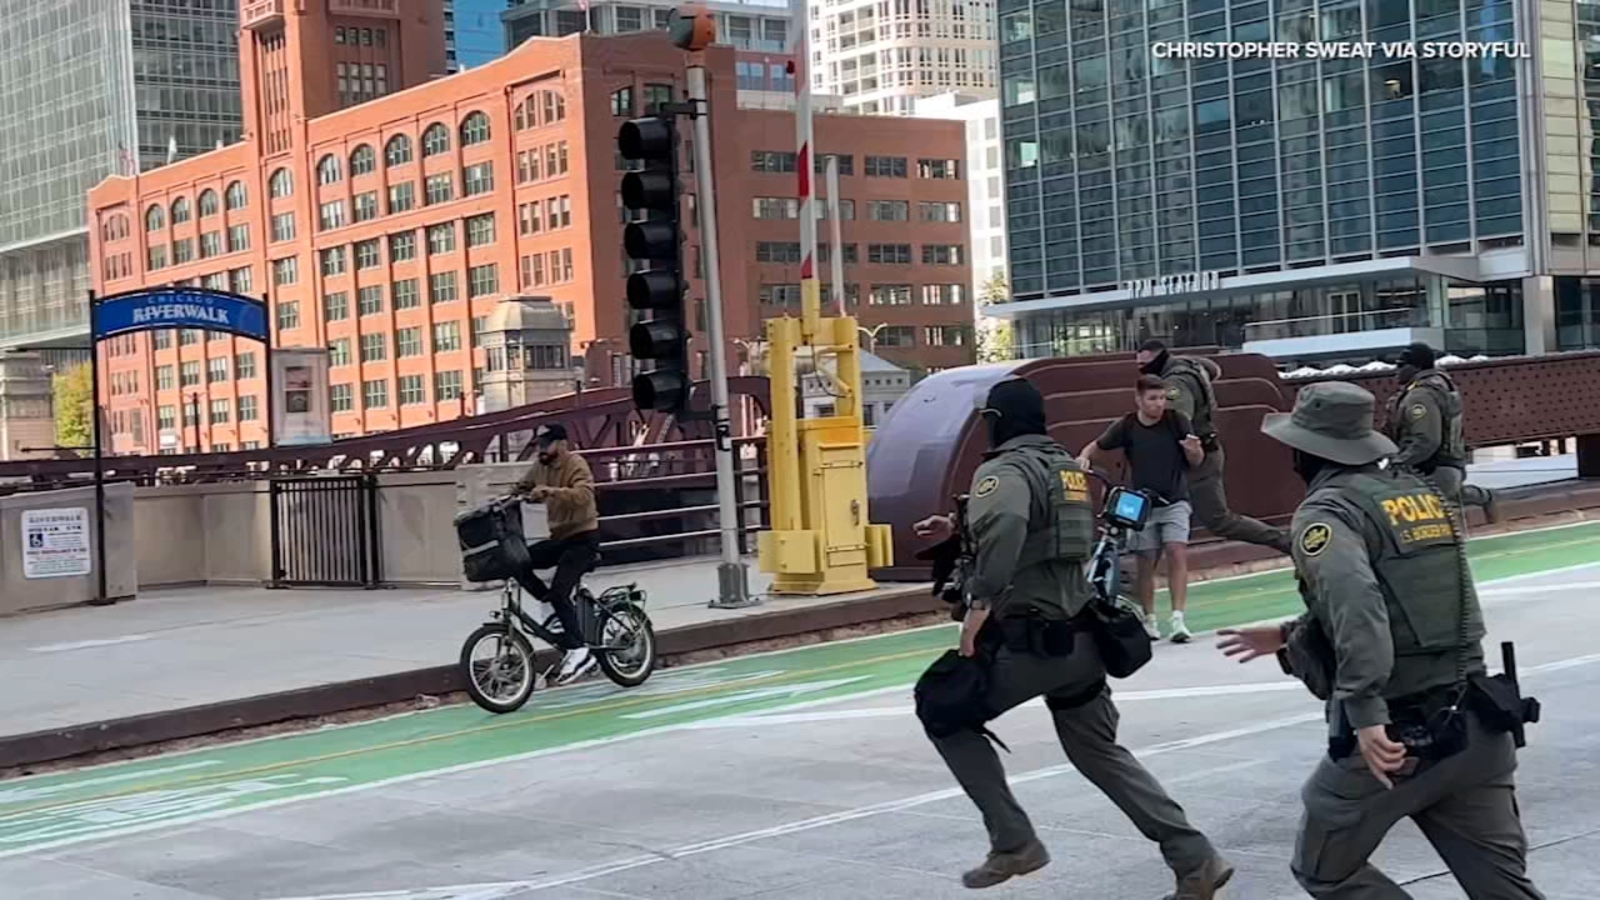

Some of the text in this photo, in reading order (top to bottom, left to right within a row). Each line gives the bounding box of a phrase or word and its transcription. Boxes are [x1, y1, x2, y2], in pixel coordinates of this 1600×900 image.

[147, 294, 214, 304] CHICAGO
[132, 303, 230, 324] RIVERWALK
[1381, 494, 1446, 526] POLIC
